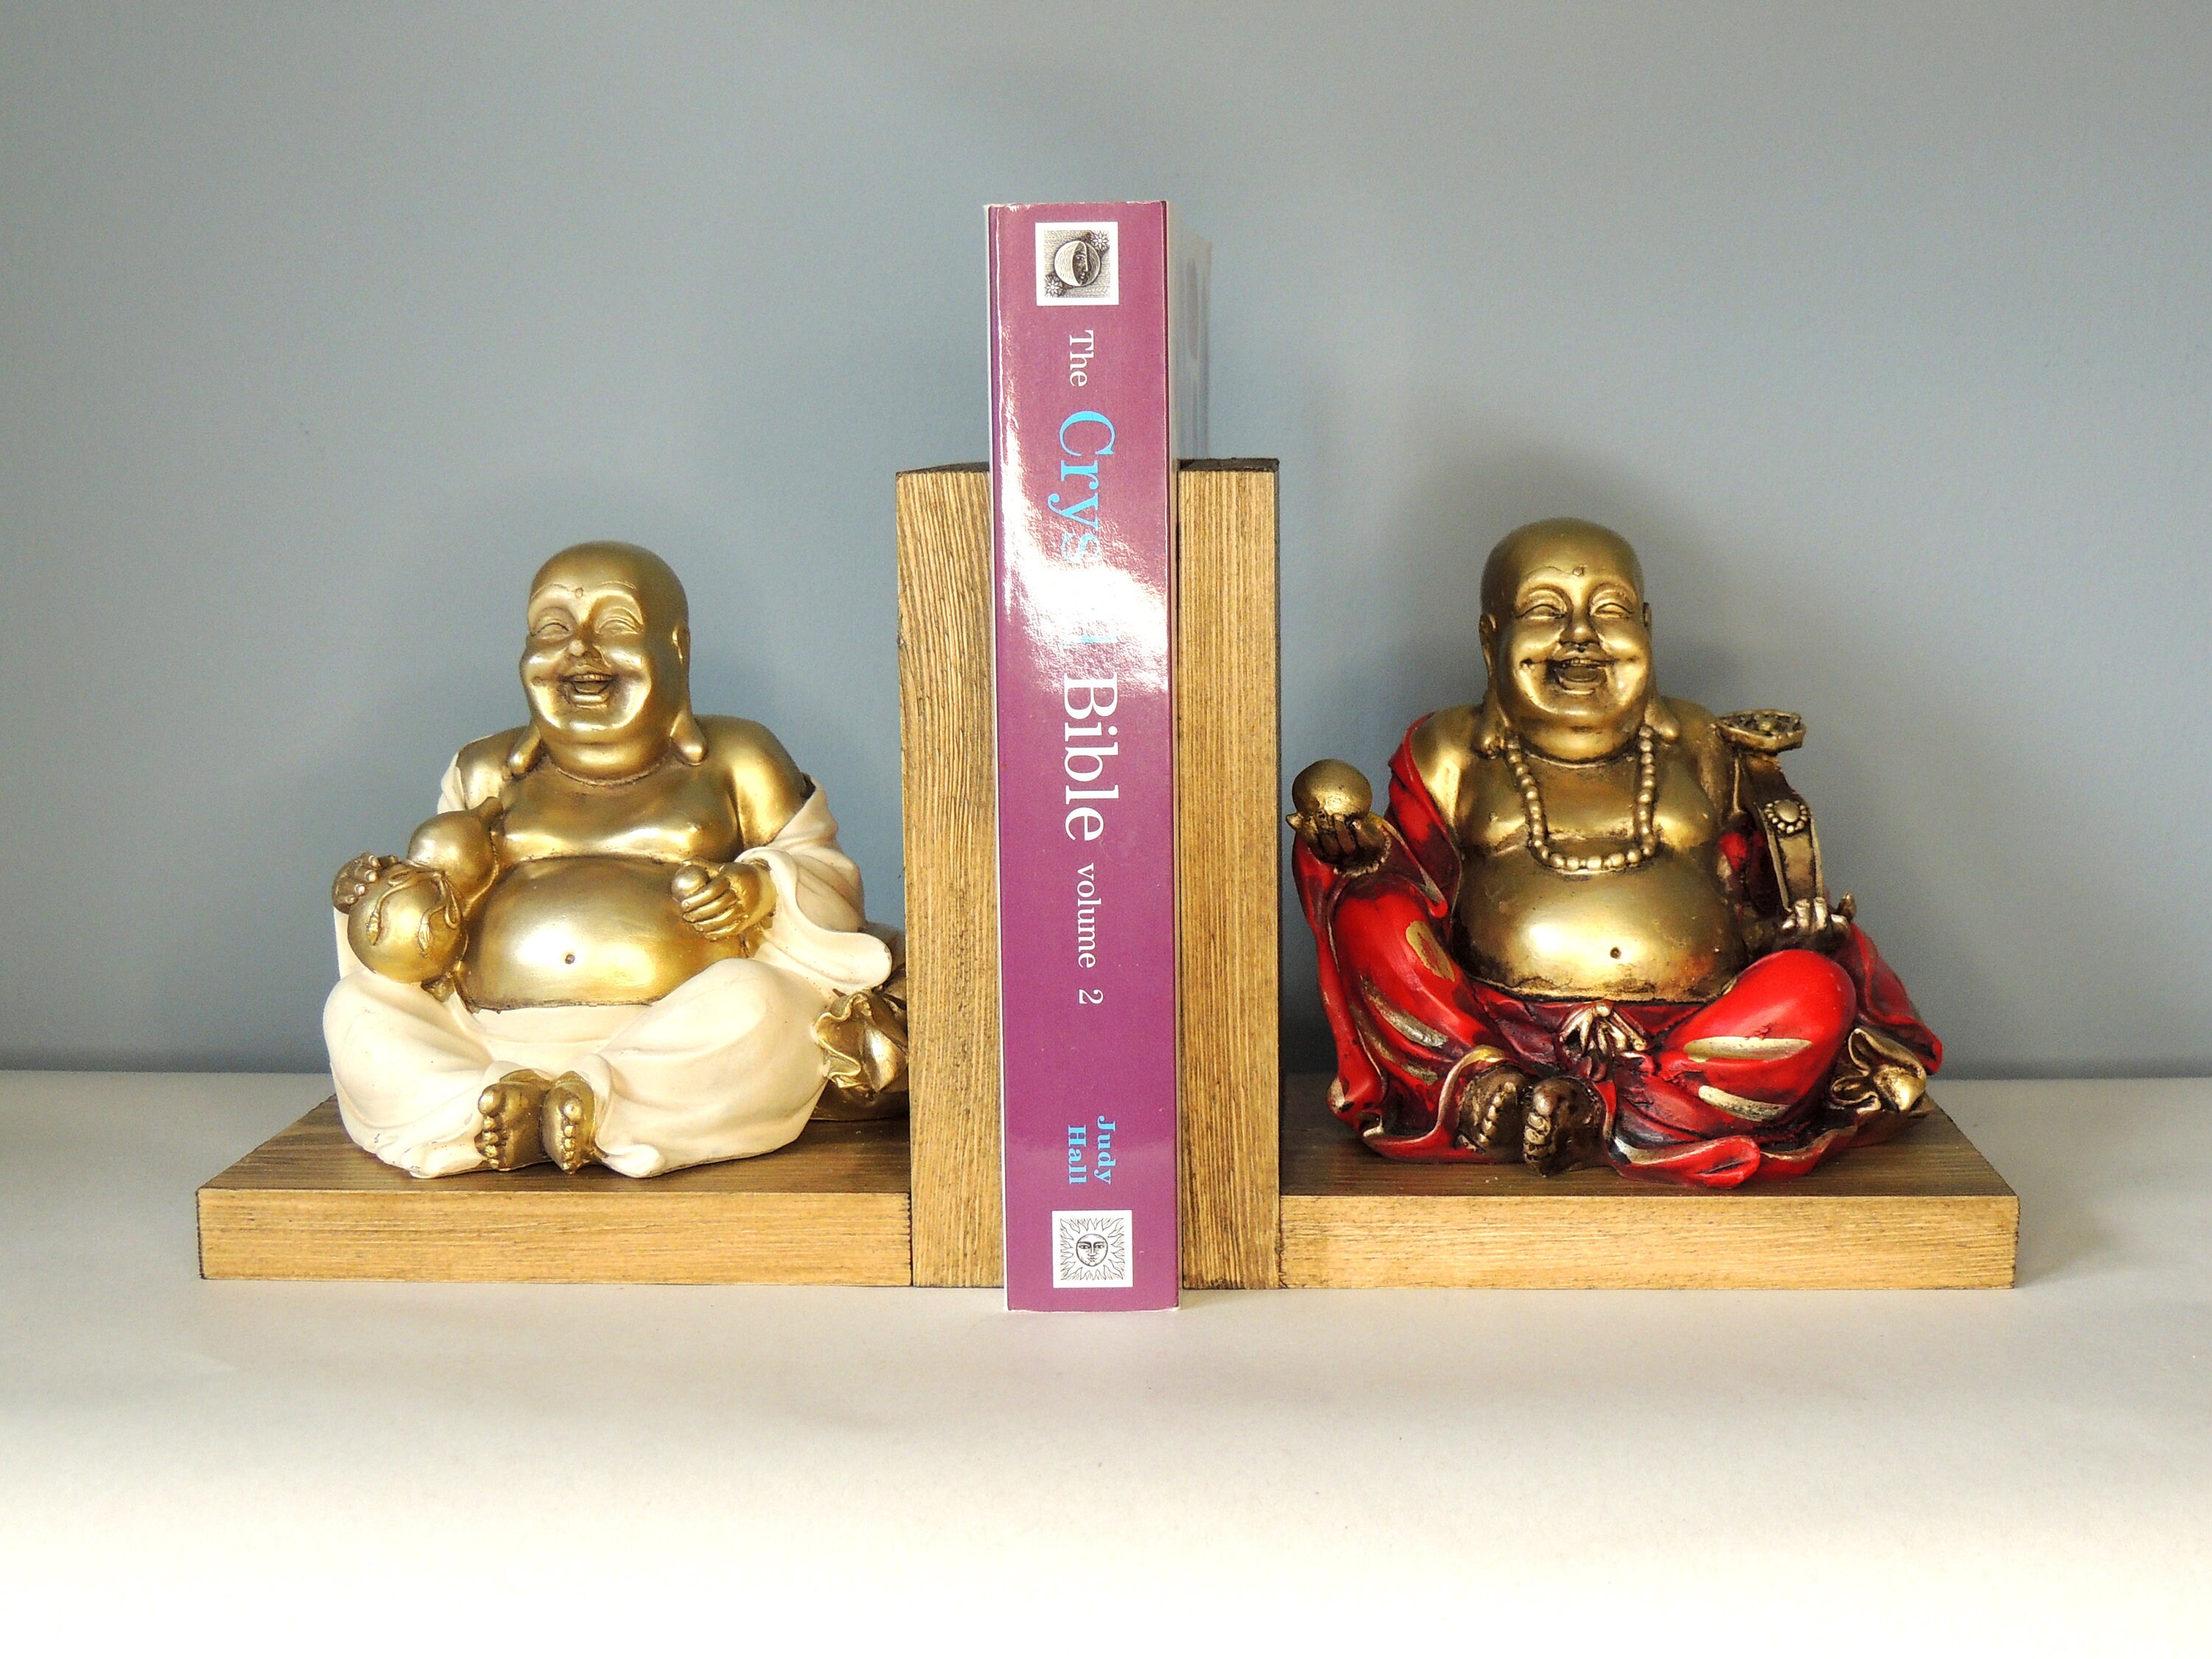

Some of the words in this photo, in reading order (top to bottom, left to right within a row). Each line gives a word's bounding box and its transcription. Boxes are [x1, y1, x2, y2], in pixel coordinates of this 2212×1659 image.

[1068, 330, 1094, 387] The
[1047, 410, 1116, 644] Crysl
[1063, 672, 1119, 841] Bible
[1076, 862, 1102, 969] volume
[1078, 988, 1104, 1005] 2
[1068, 1124, 1088, 1185] Hall
[1093, 1115, 1116, 1185] Judy
